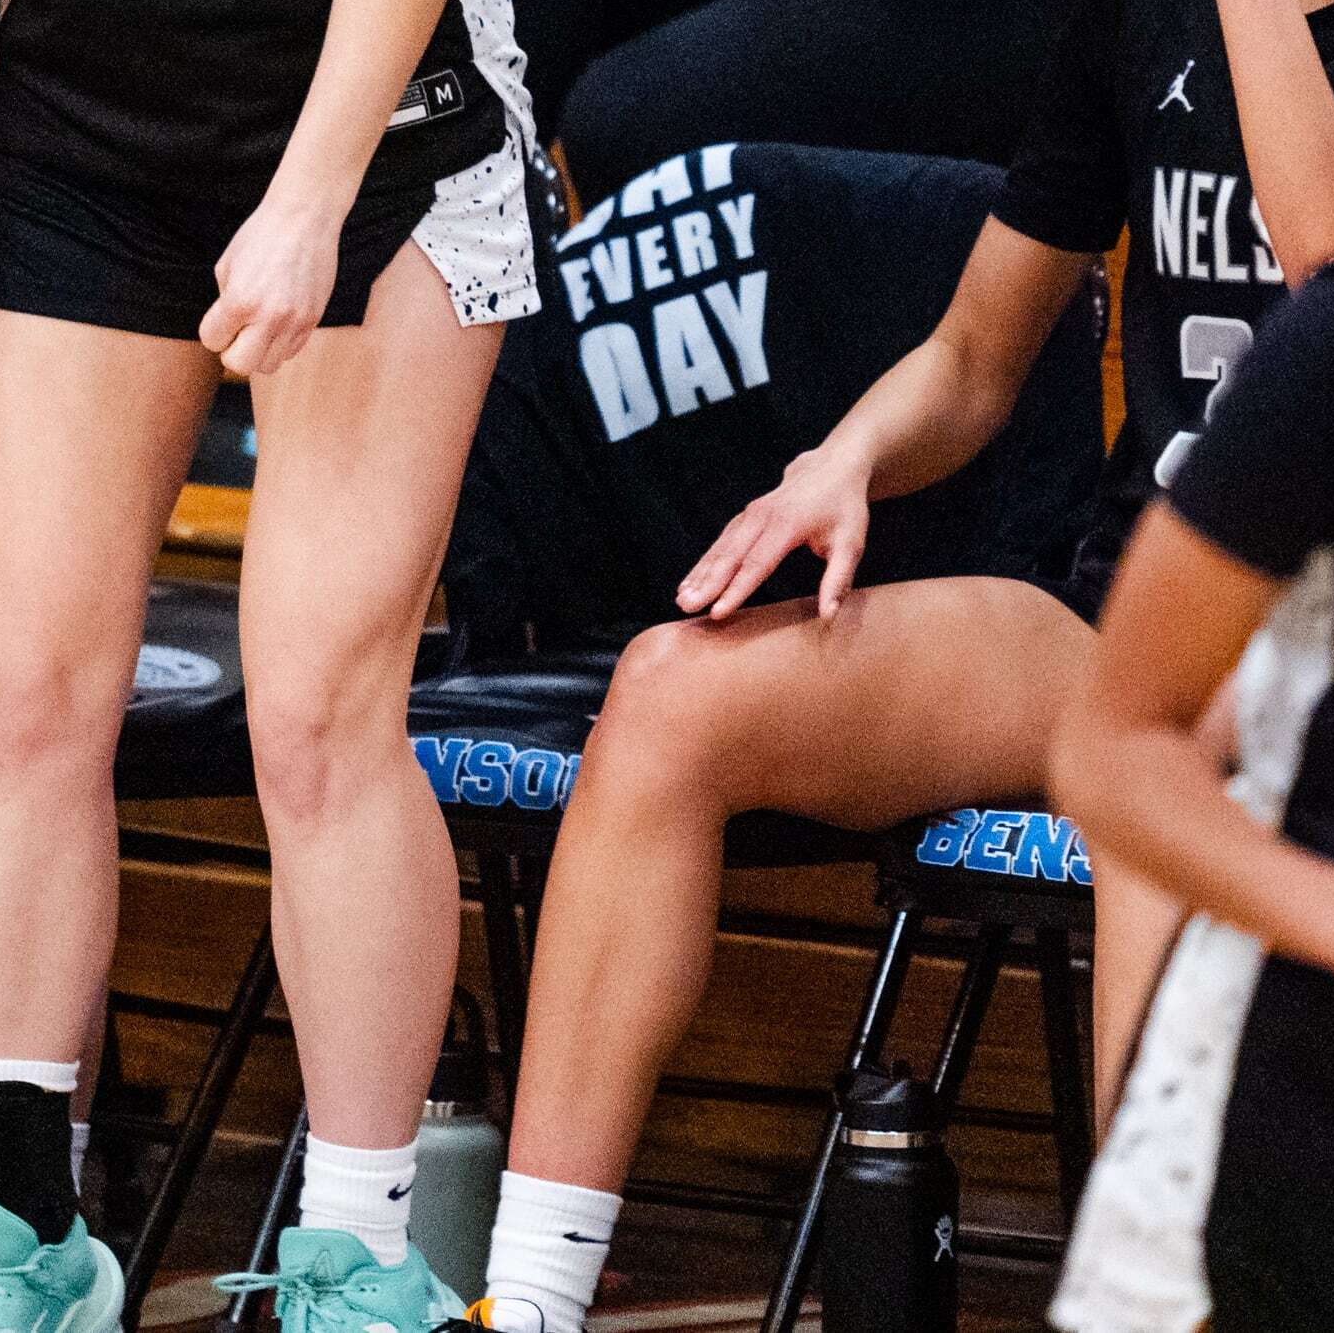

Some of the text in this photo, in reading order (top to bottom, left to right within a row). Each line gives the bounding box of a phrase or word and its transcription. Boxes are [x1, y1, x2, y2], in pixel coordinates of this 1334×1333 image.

[434, 82, 454, 105] M
[559, 192, 756, 324] EVERY
[578, 269, 770, 444] DAY
